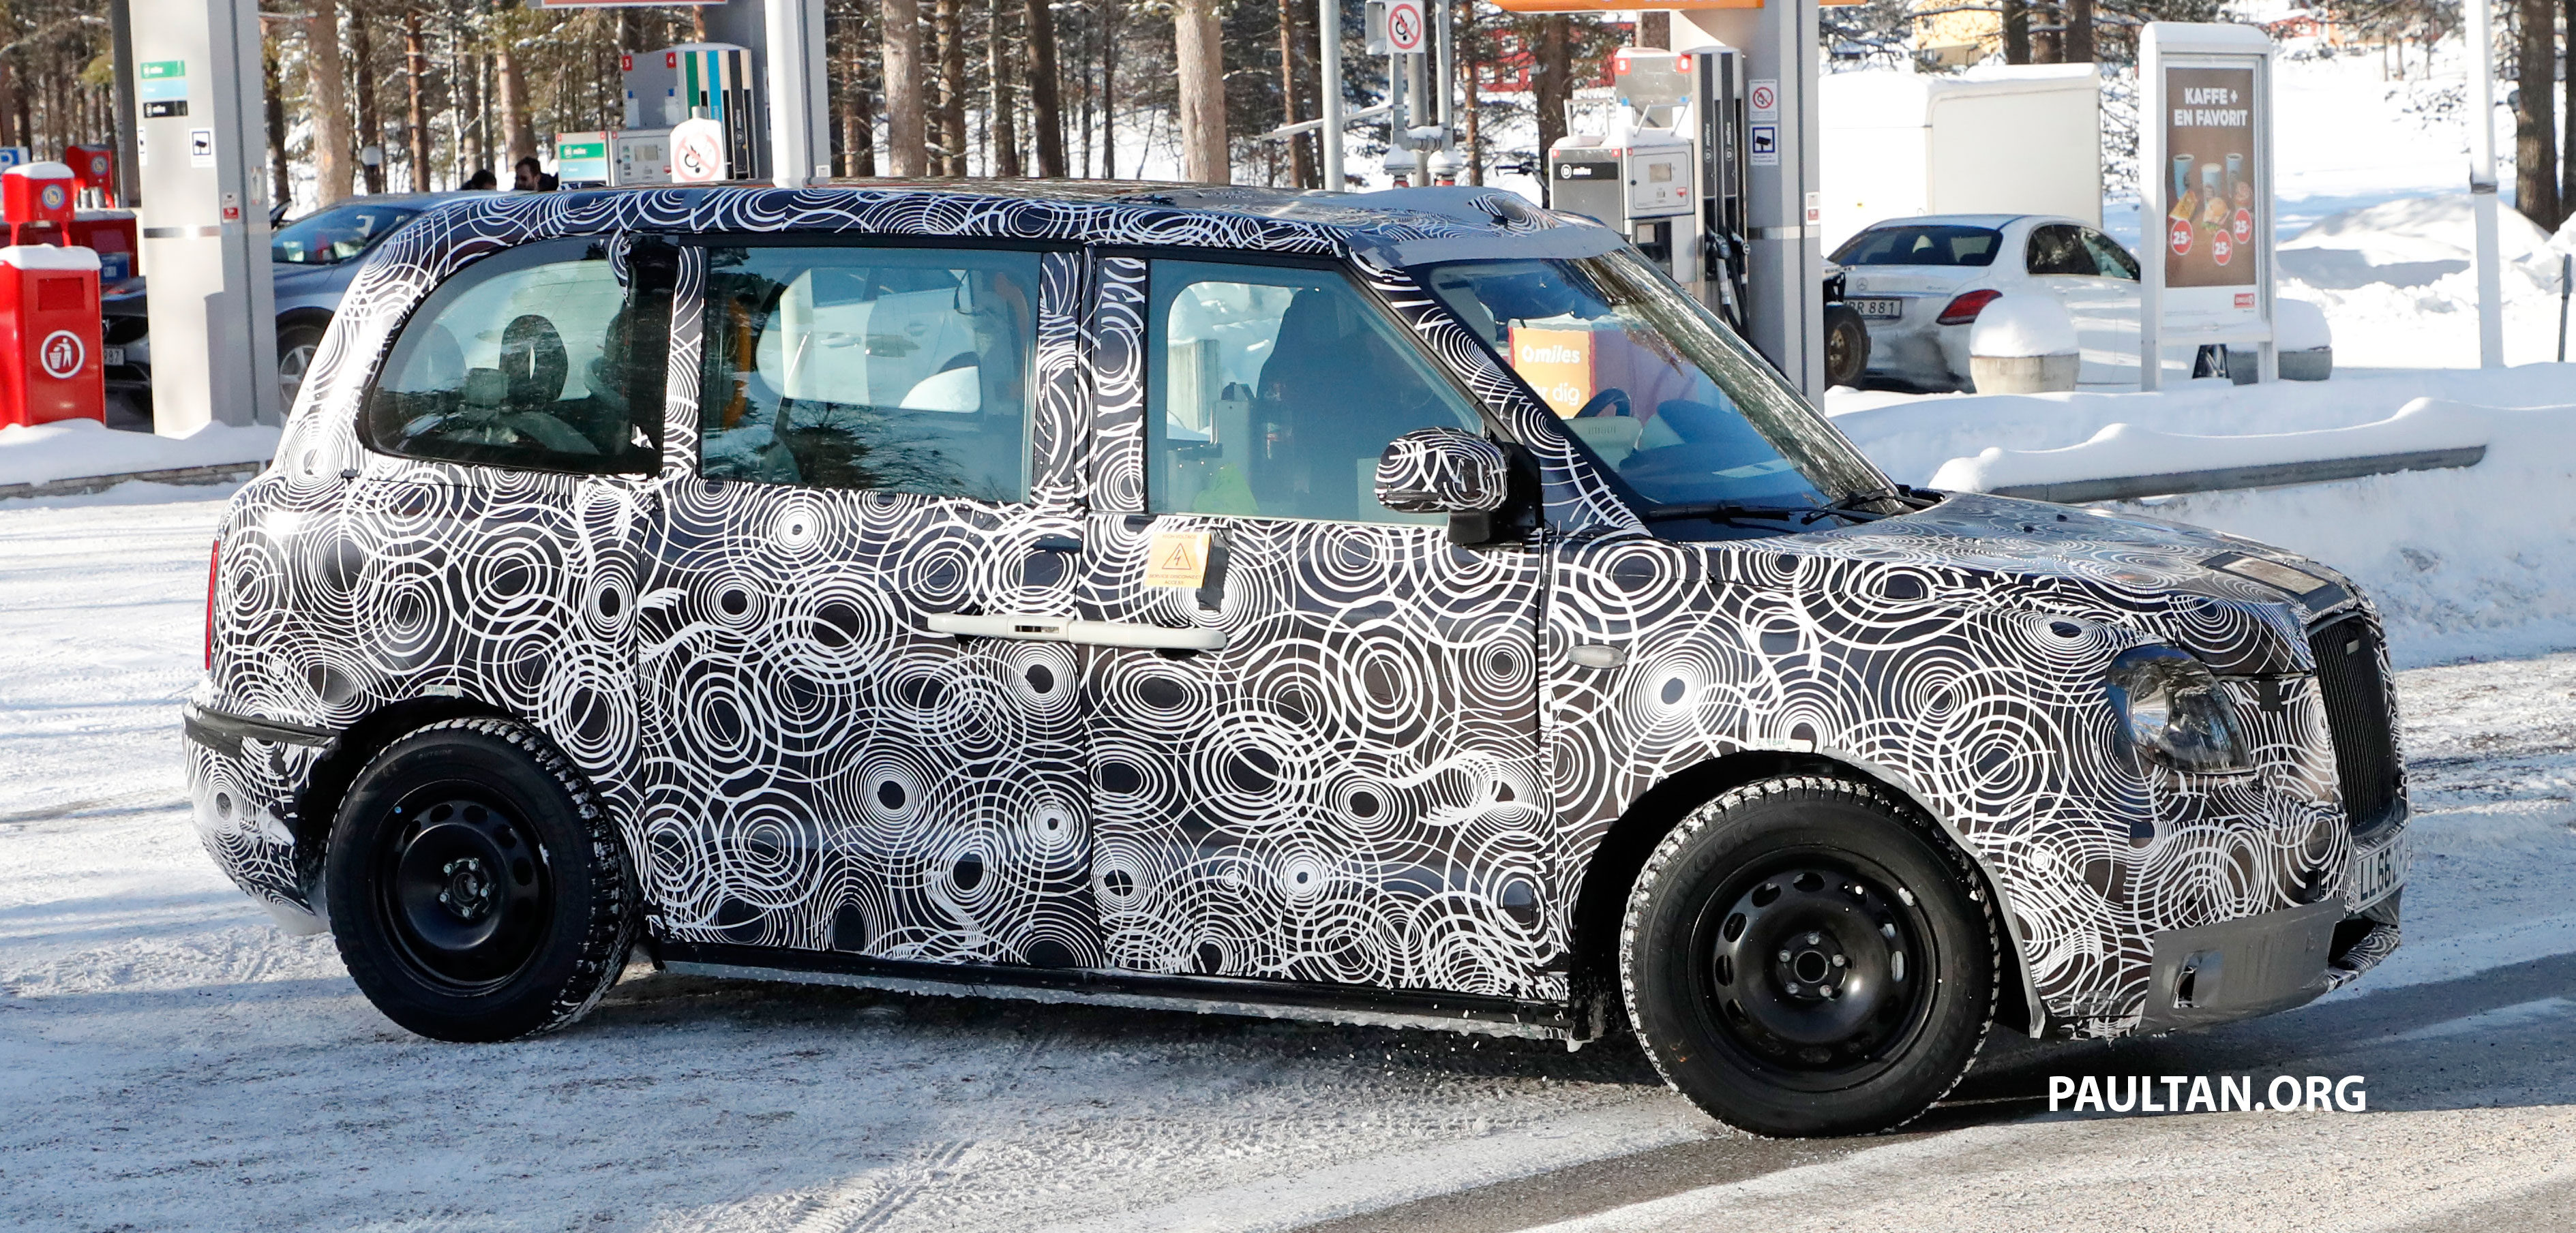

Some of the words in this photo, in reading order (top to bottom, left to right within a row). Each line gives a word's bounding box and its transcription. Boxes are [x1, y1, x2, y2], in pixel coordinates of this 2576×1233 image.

[1619, 60, 1626, 70] 5
[2185, 87, 2228, 105] KAFFE
[2174, 109, 2193, 127] EN
[2196, 109, 2248, 127] FAVORIT
[1869, 301, 1894, 314] 881
[1552, 382, 1581, 406] dig
[2360, 847, 2391, 901] LL66
